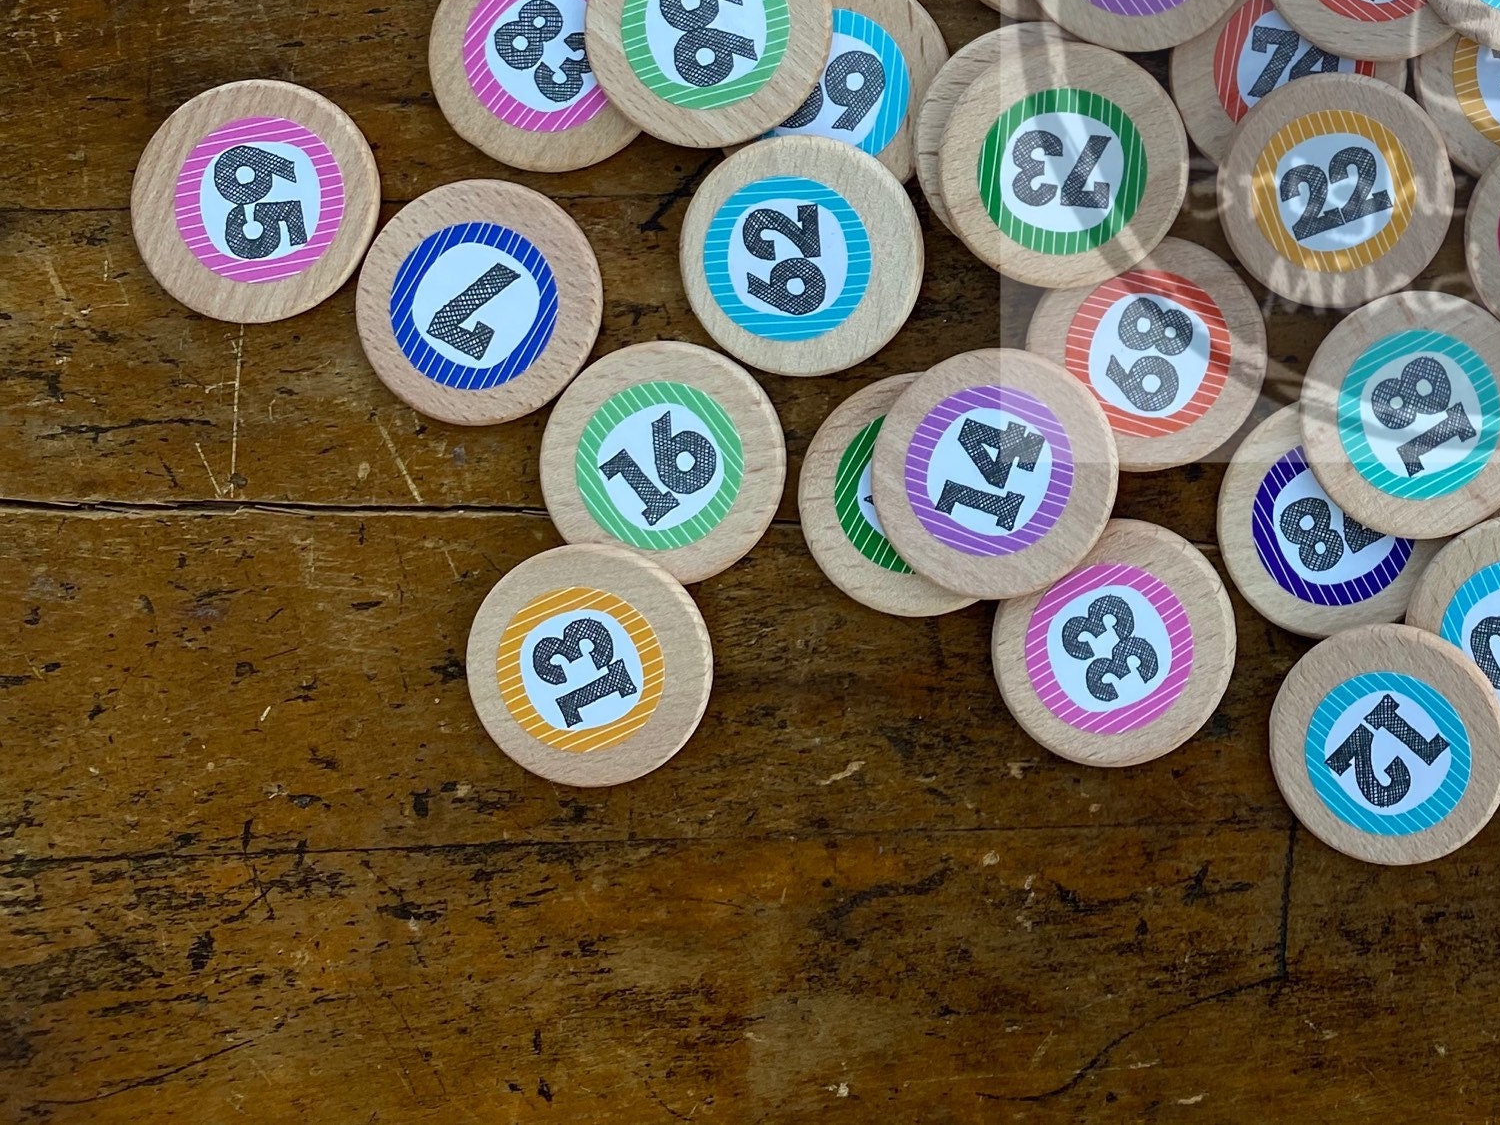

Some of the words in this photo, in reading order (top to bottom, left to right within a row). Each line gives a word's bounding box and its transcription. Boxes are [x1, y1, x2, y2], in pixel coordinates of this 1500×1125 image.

[495, 0, 594, 104] 83
[214, 146, 309, 261] 65
[1013, 130, 1114, 211] 73
[1280, 147, 1392, 242] 22
[428, 263, 523, 362] 7
[743, 205, 828, 316] 62
[600, 413, 718, 528] 16
[1371, 357, 1478, 477] 18
[935, 419, 1046, 533] 14
[533, 619, 638, 730] 13
[1062, 596, 1160, 704] 33
[1325, 693, 1450, 809] 12
